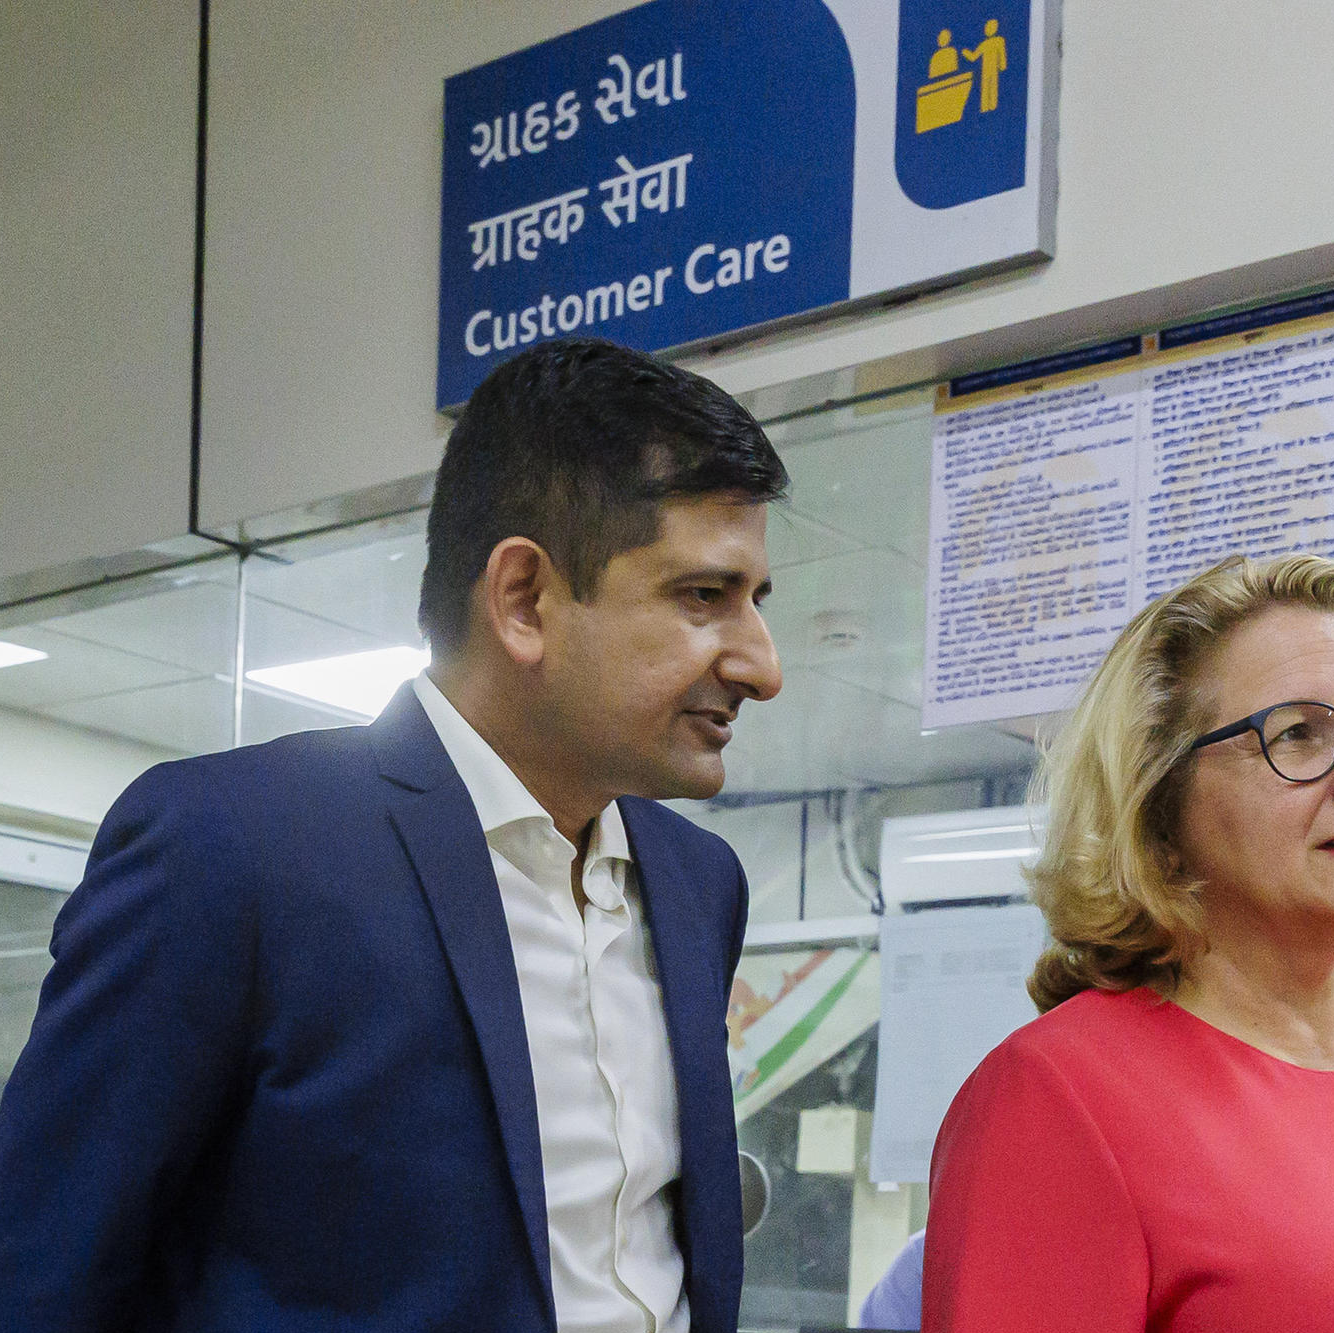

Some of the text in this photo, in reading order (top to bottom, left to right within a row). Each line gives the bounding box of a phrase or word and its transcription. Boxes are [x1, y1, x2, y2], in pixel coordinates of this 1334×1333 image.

[469, 52, 687, 169] ગ્રાહક સેવા
[468, 152, 694, 272] ग्राहक सेवा
[465, 234, 791, 357] Customer Care
